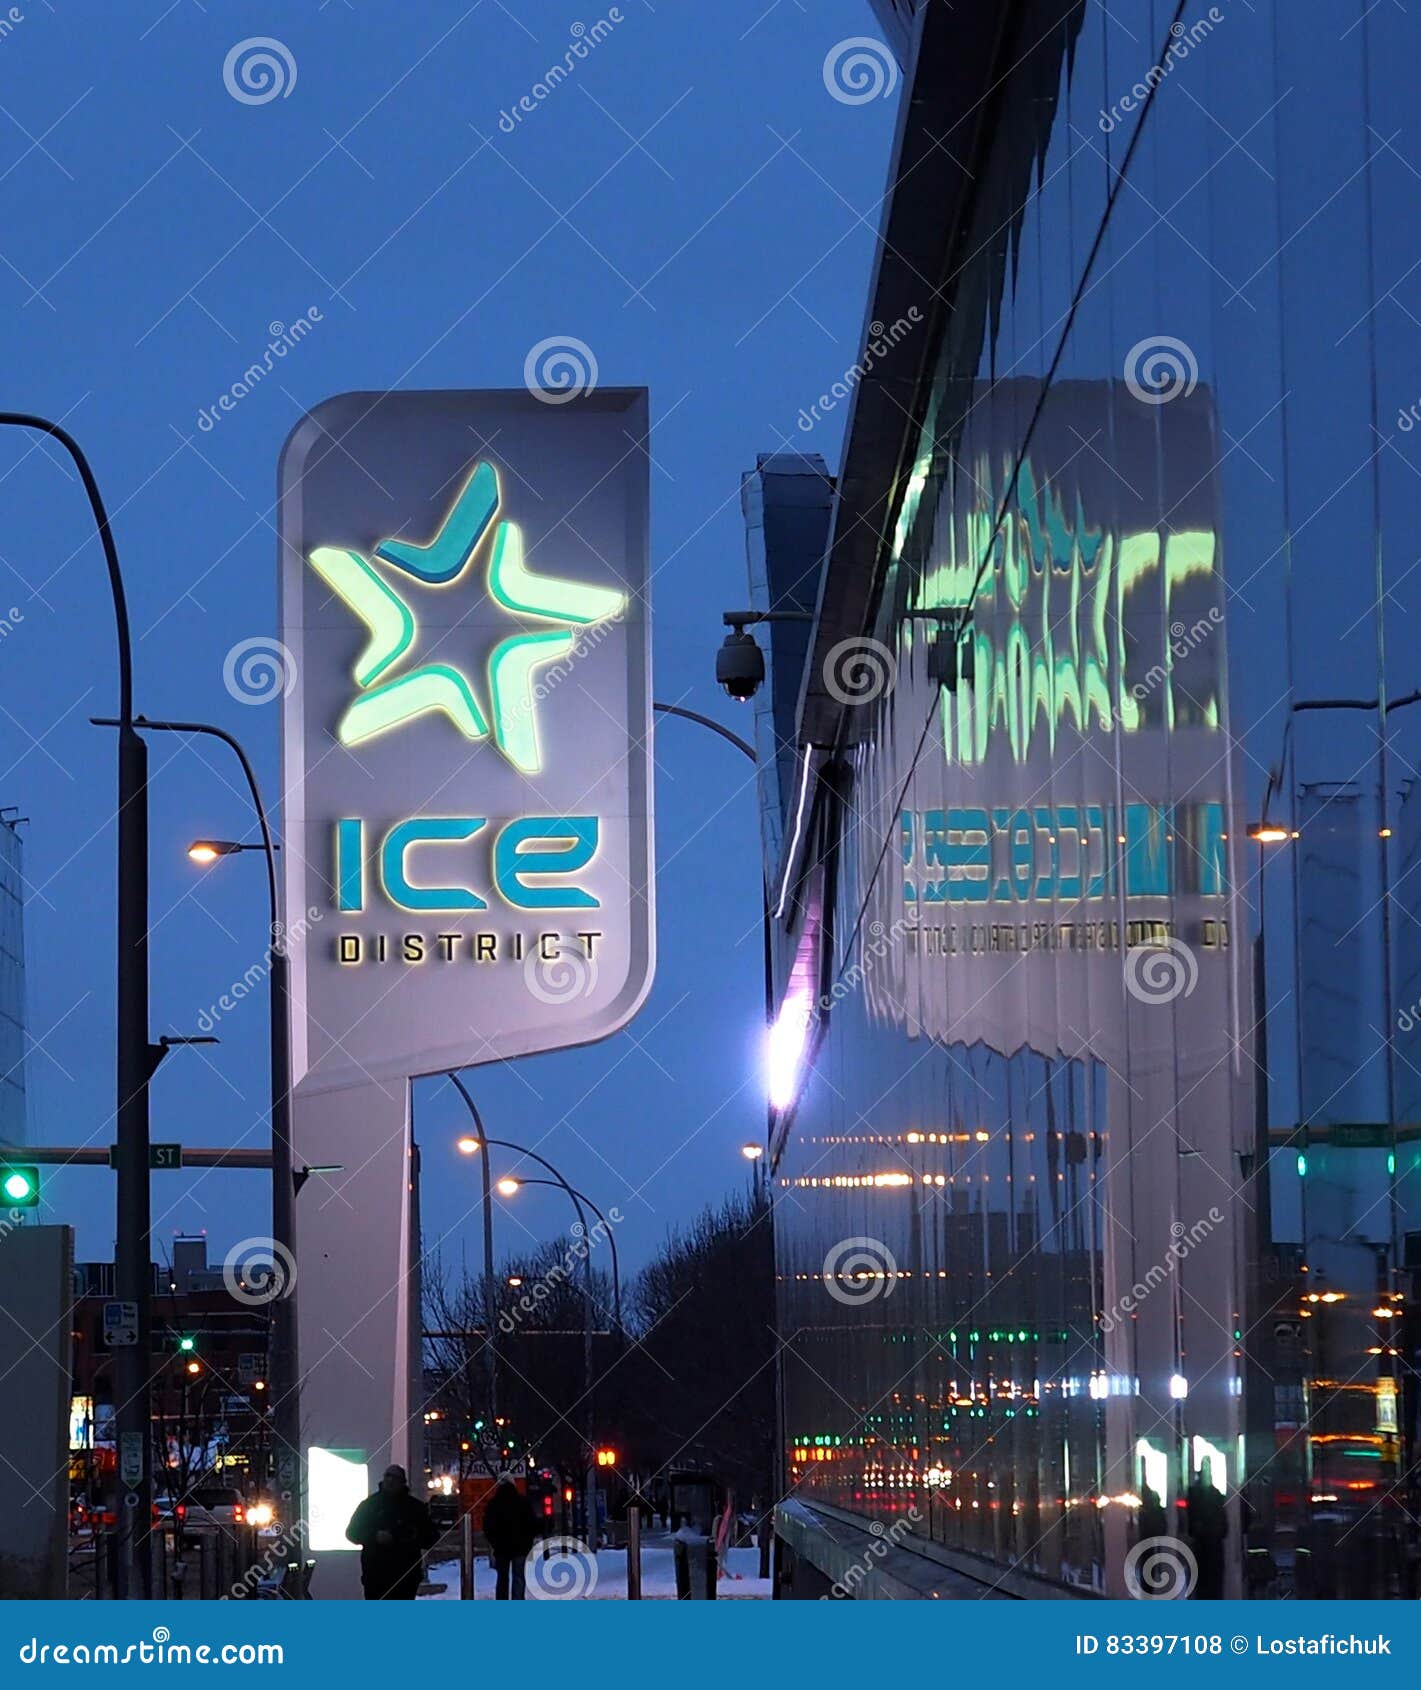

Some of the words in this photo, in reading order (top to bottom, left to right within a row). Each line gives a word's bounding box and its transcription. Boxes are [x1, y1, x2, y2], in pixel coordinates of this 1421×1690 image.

[336, 816, 600, 912] ICE
[339, 932, 603, 966] DISTRICT
[156, 1147, 176, 1165] ST
